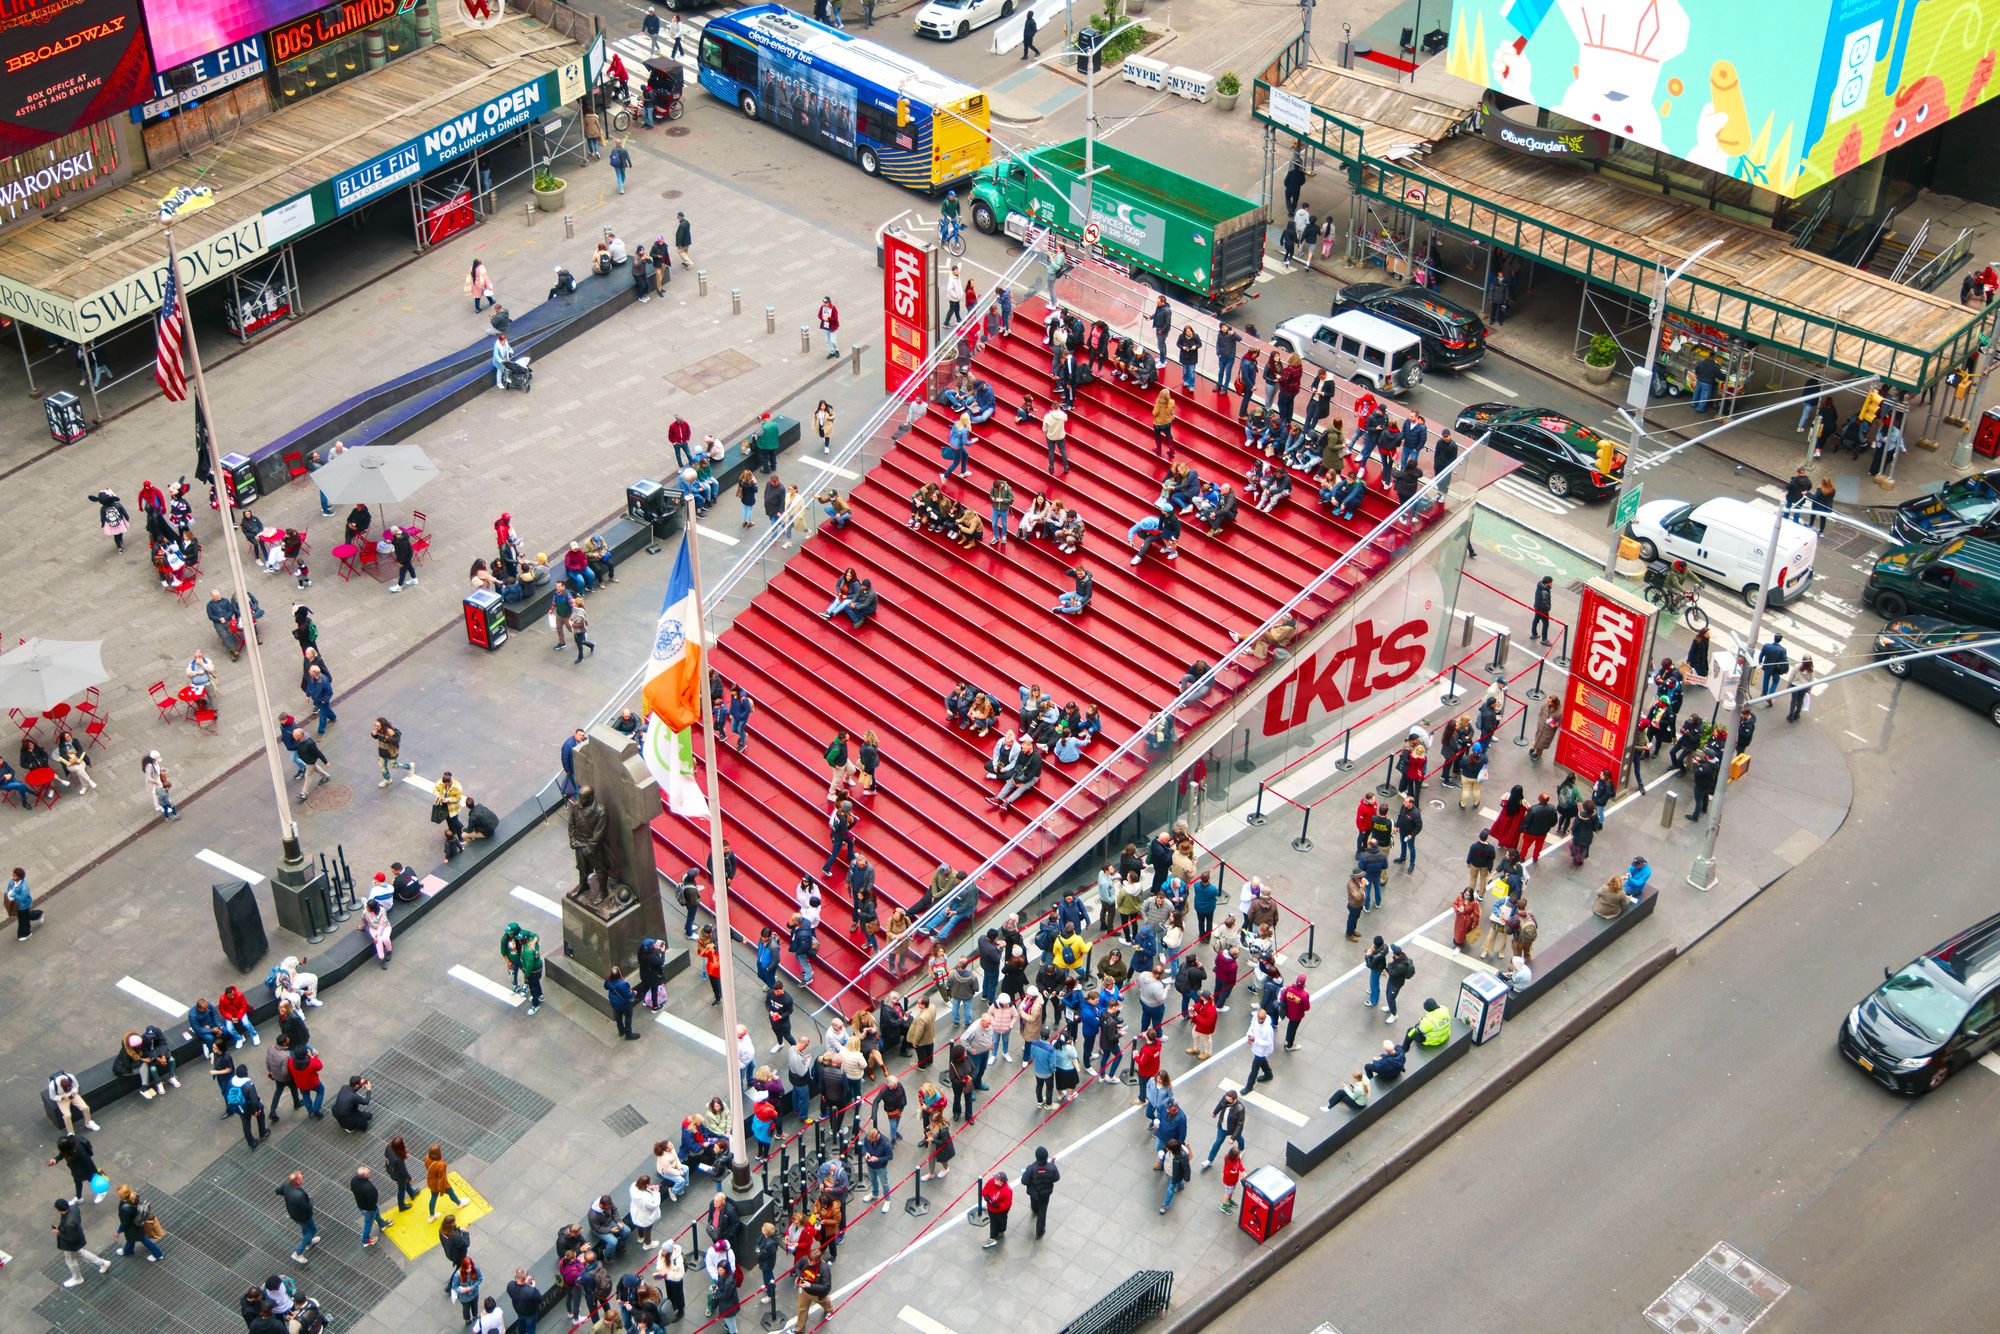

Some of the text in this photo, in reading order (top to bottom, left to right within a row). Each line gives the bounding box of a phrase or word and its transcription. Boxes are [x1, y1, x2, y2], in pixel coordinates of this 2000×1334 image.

[5, 16, 126, 72] BROADWAY
[217, 38, 259, 73] FIN
[275, 23, 313, 59] DOS
[748, 30, 798, 59] clean-energy
[797, 50, 814, 65] bus
[26, 73, 87, 103] BOX OFFICE AT
[146, 61, 262, 115] SEAFOOD SUSHI
[1128, 65, 1156, 82] NYPD
[1172, 77, 1201, 94] NYPD
[15, 77, 102, 117] 45TH ST AND 8TH AVE
[424, 82, 540, 156] NOW OPEN
[439, 146, 458, 162] FOR
[459, 130, 488, 152] LUNCH
[489, 127, 497, 136] &
[497, 110, 530, 132] DINNER
[1501, 129, 1567, 153] Olive Garden
[340, 147, 416, 197] BLUE FIN
[1091, 210, 1124, 231] ERVICES
[1124, 223, 1146, 239] CORP
[1108, 227, 1140, 246] 326-7900
[80, 220, 263, 333] SWAROVSKI
[895, 248, 920, 319] tkts
[0, 285, 76, 332] ROVSKI
[1587, 605, 1633, 686] tkts
[1263, 619, 1429, 736] tkts
